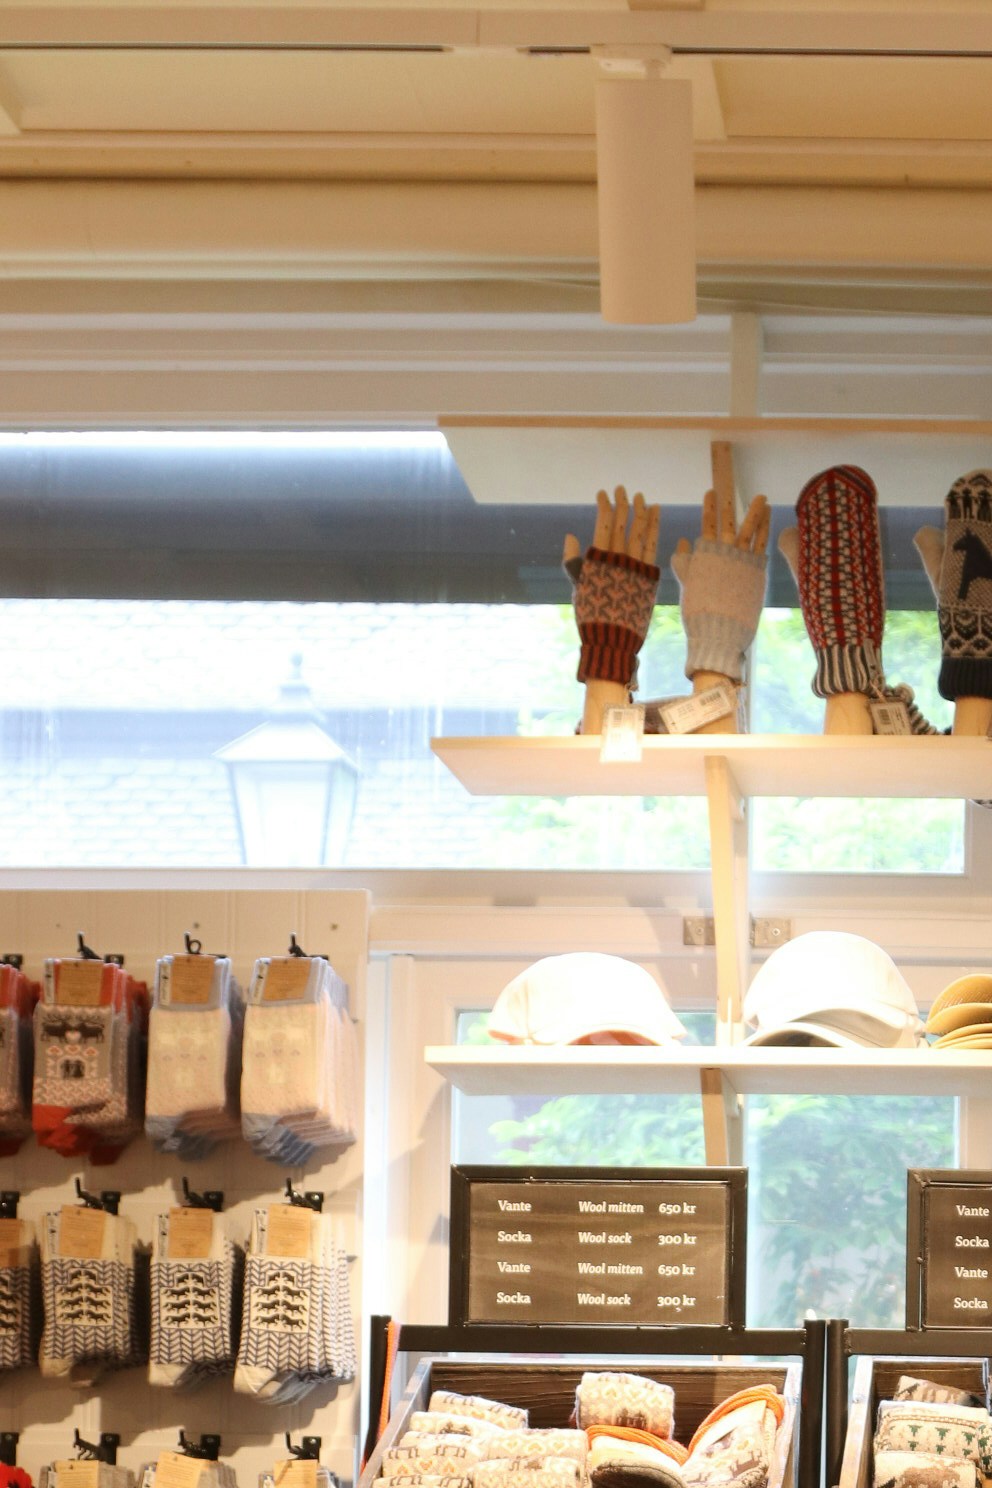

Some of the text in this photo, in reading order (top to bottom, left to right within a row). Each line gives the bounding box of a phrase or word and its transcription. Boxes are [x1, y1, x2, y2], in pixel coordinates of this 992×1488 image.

[498, 1200, 696, 1214] Vante Wool mitten 650 kr
[956, 1205, 989, 1216] Vante
[498, 1231, 696, 1245] Socka Wool sock 300 kr
[955, 1236, 989, 1247] Socka
[497, 1262, 695, 1276] Vante Wool mitten 650 kr
[955, 1267, 988, 1279] Vante
[497, 1292, 696, 1306] Socka Wool sock 300 kr
[954, 1297, 988, 1308] Socka
